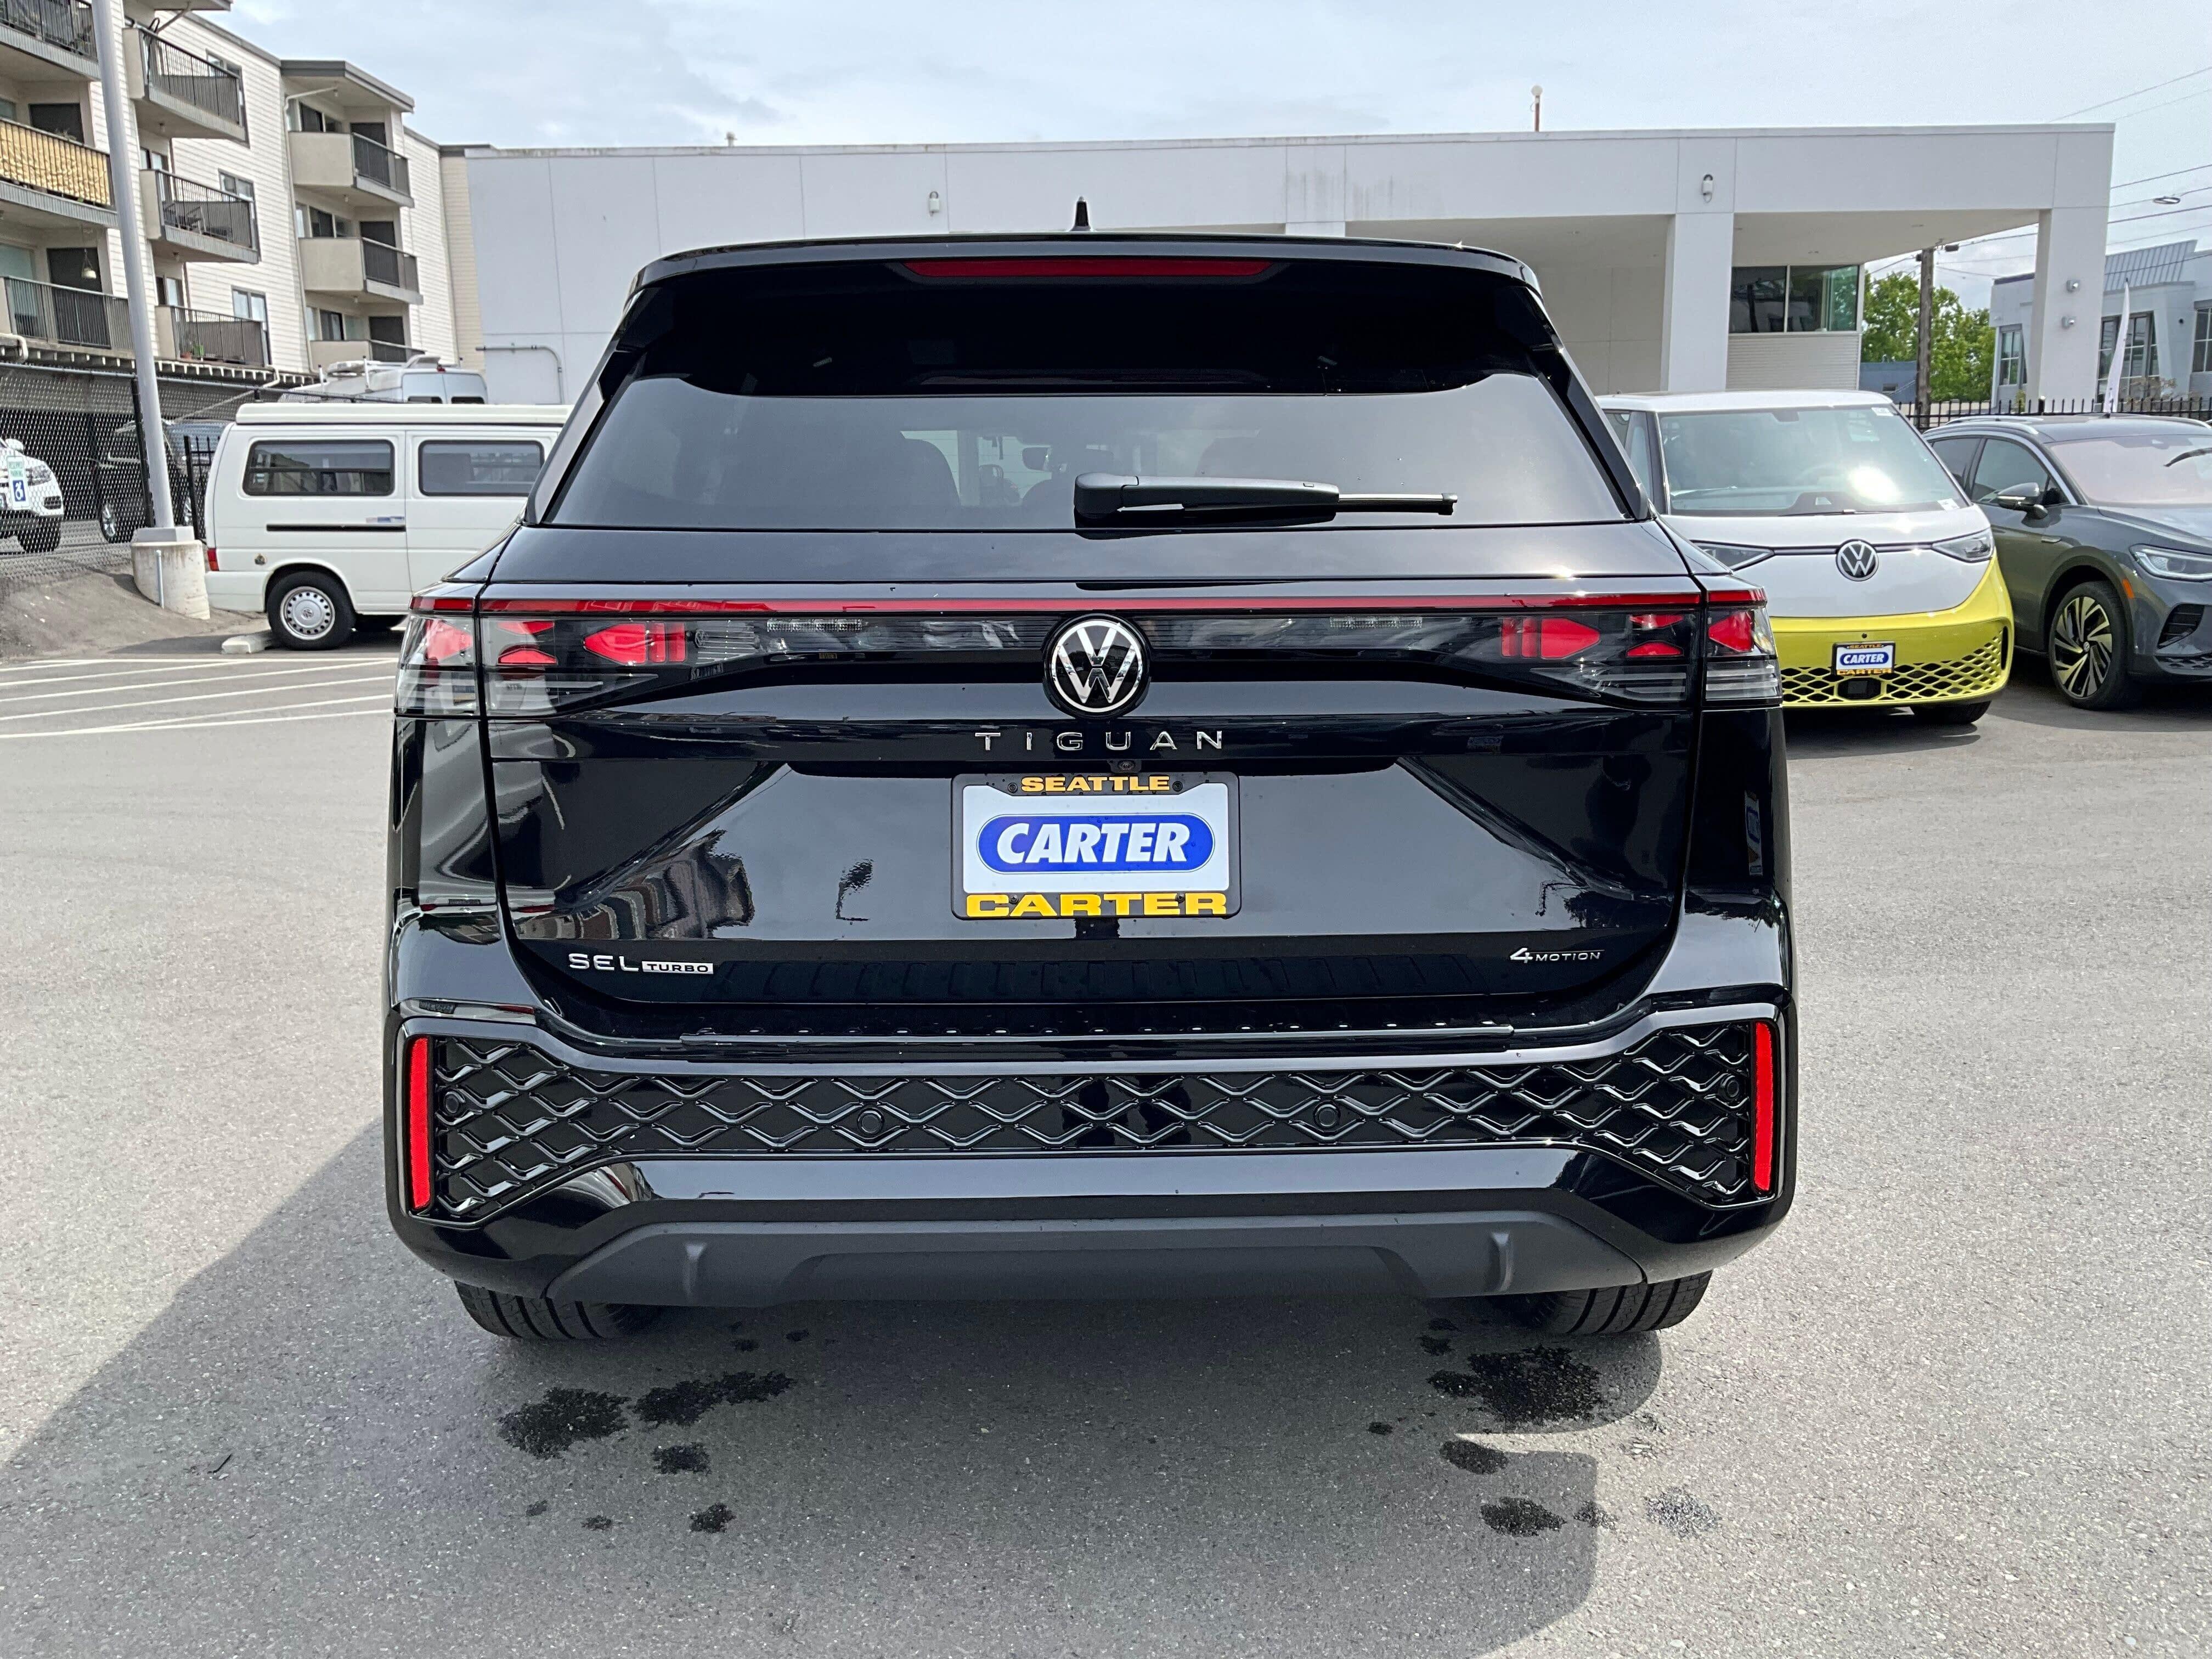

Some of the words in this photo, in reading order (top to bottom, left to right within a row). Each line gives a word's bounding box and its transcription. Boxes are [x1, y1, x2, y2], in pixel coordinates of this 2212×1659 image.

[1838, 541, 1877, 580] VW
[1052, 621, 1141, 712] VW
[1843, 653, 1884, 664] CARTER
[975, 731, 1222, 751] TIGUAN
[1021, 776, 1170, 792] SEATTLE
[997, 823, 1190, 863] CARTER
[966, 894, 1227, 917] CARTER
[568, 953, 639, 972] SEL
[647, 963, 708, 973] TURBO
[1510, 947, 1601, 963] 4MOTION
